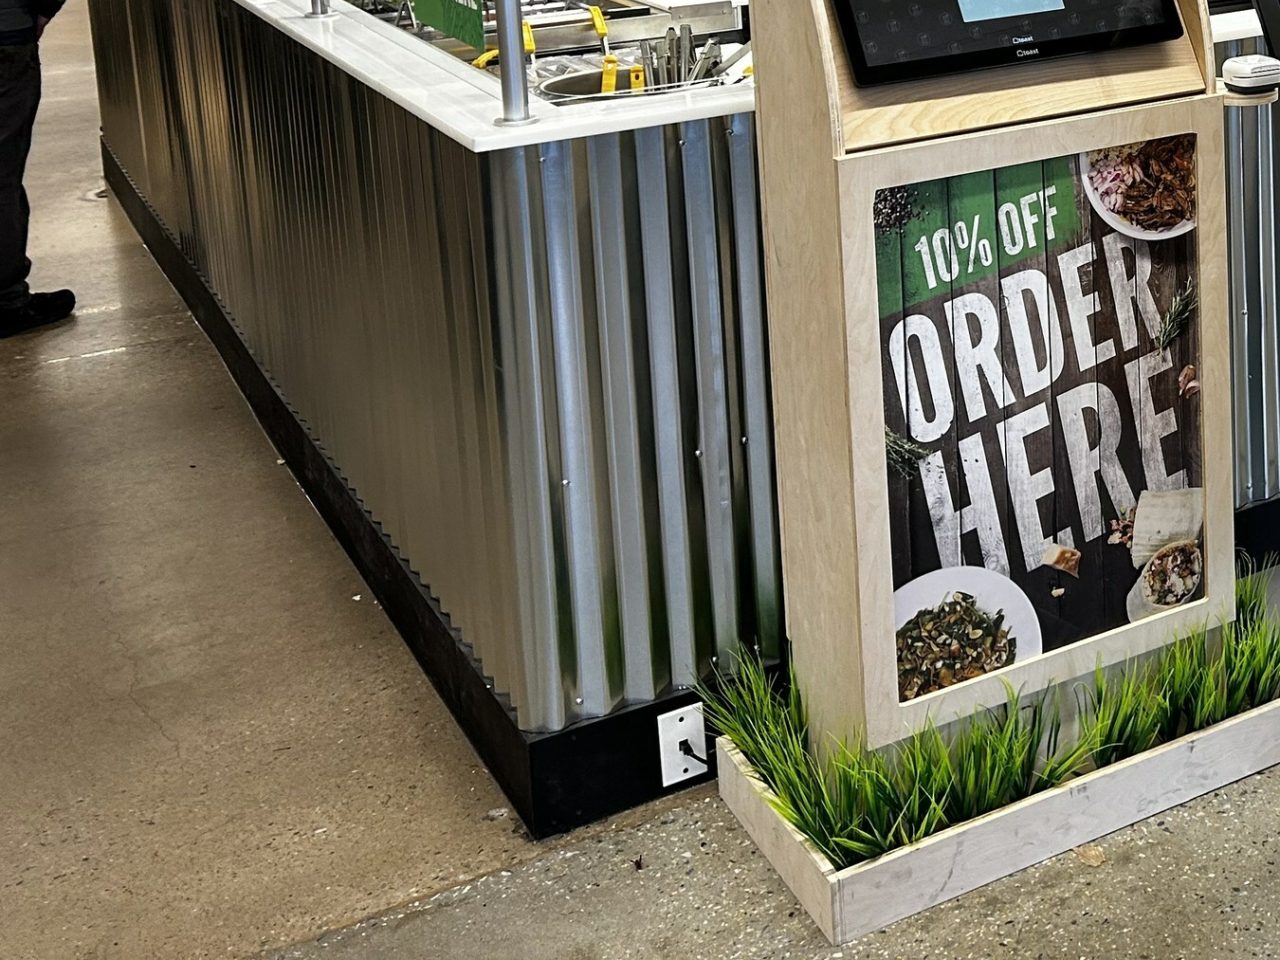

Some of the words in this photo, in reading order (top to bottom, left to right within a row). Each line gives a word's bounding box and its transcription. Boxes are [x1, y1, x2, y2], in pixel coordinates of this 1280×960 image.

[888, 231, 1164, 443] ORDER
[914, 213, 993, 290] 10%
[998, 184, 1058, 258] OFF
[916, 346, 1190, 580] HERE
